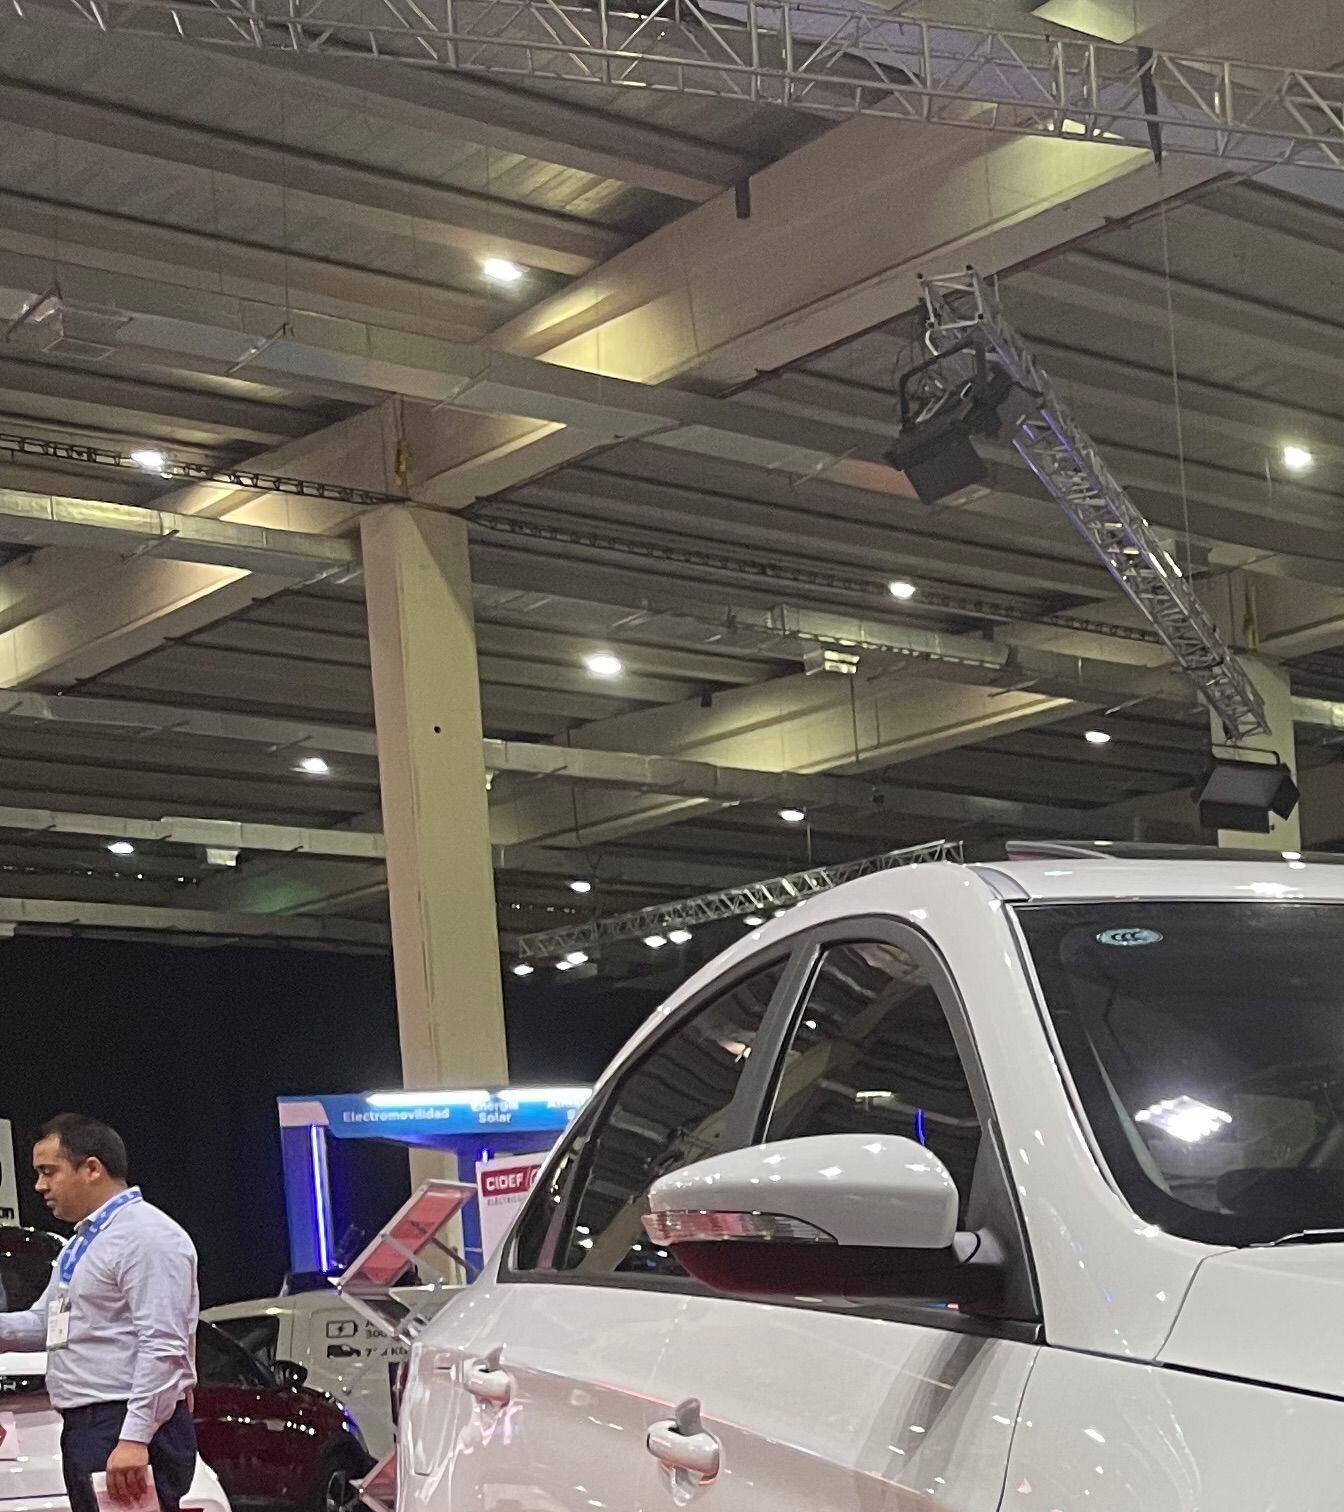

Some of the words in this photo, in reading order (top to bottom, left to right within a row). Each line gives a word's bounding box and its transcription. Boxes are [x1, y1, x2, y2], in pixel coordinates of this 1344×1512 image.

[342, 1107, 450, 1124] Electromovilidad
[478, 1111, 513, 1124] Solar
[485, 1172, 524, 1191] CIDEF
